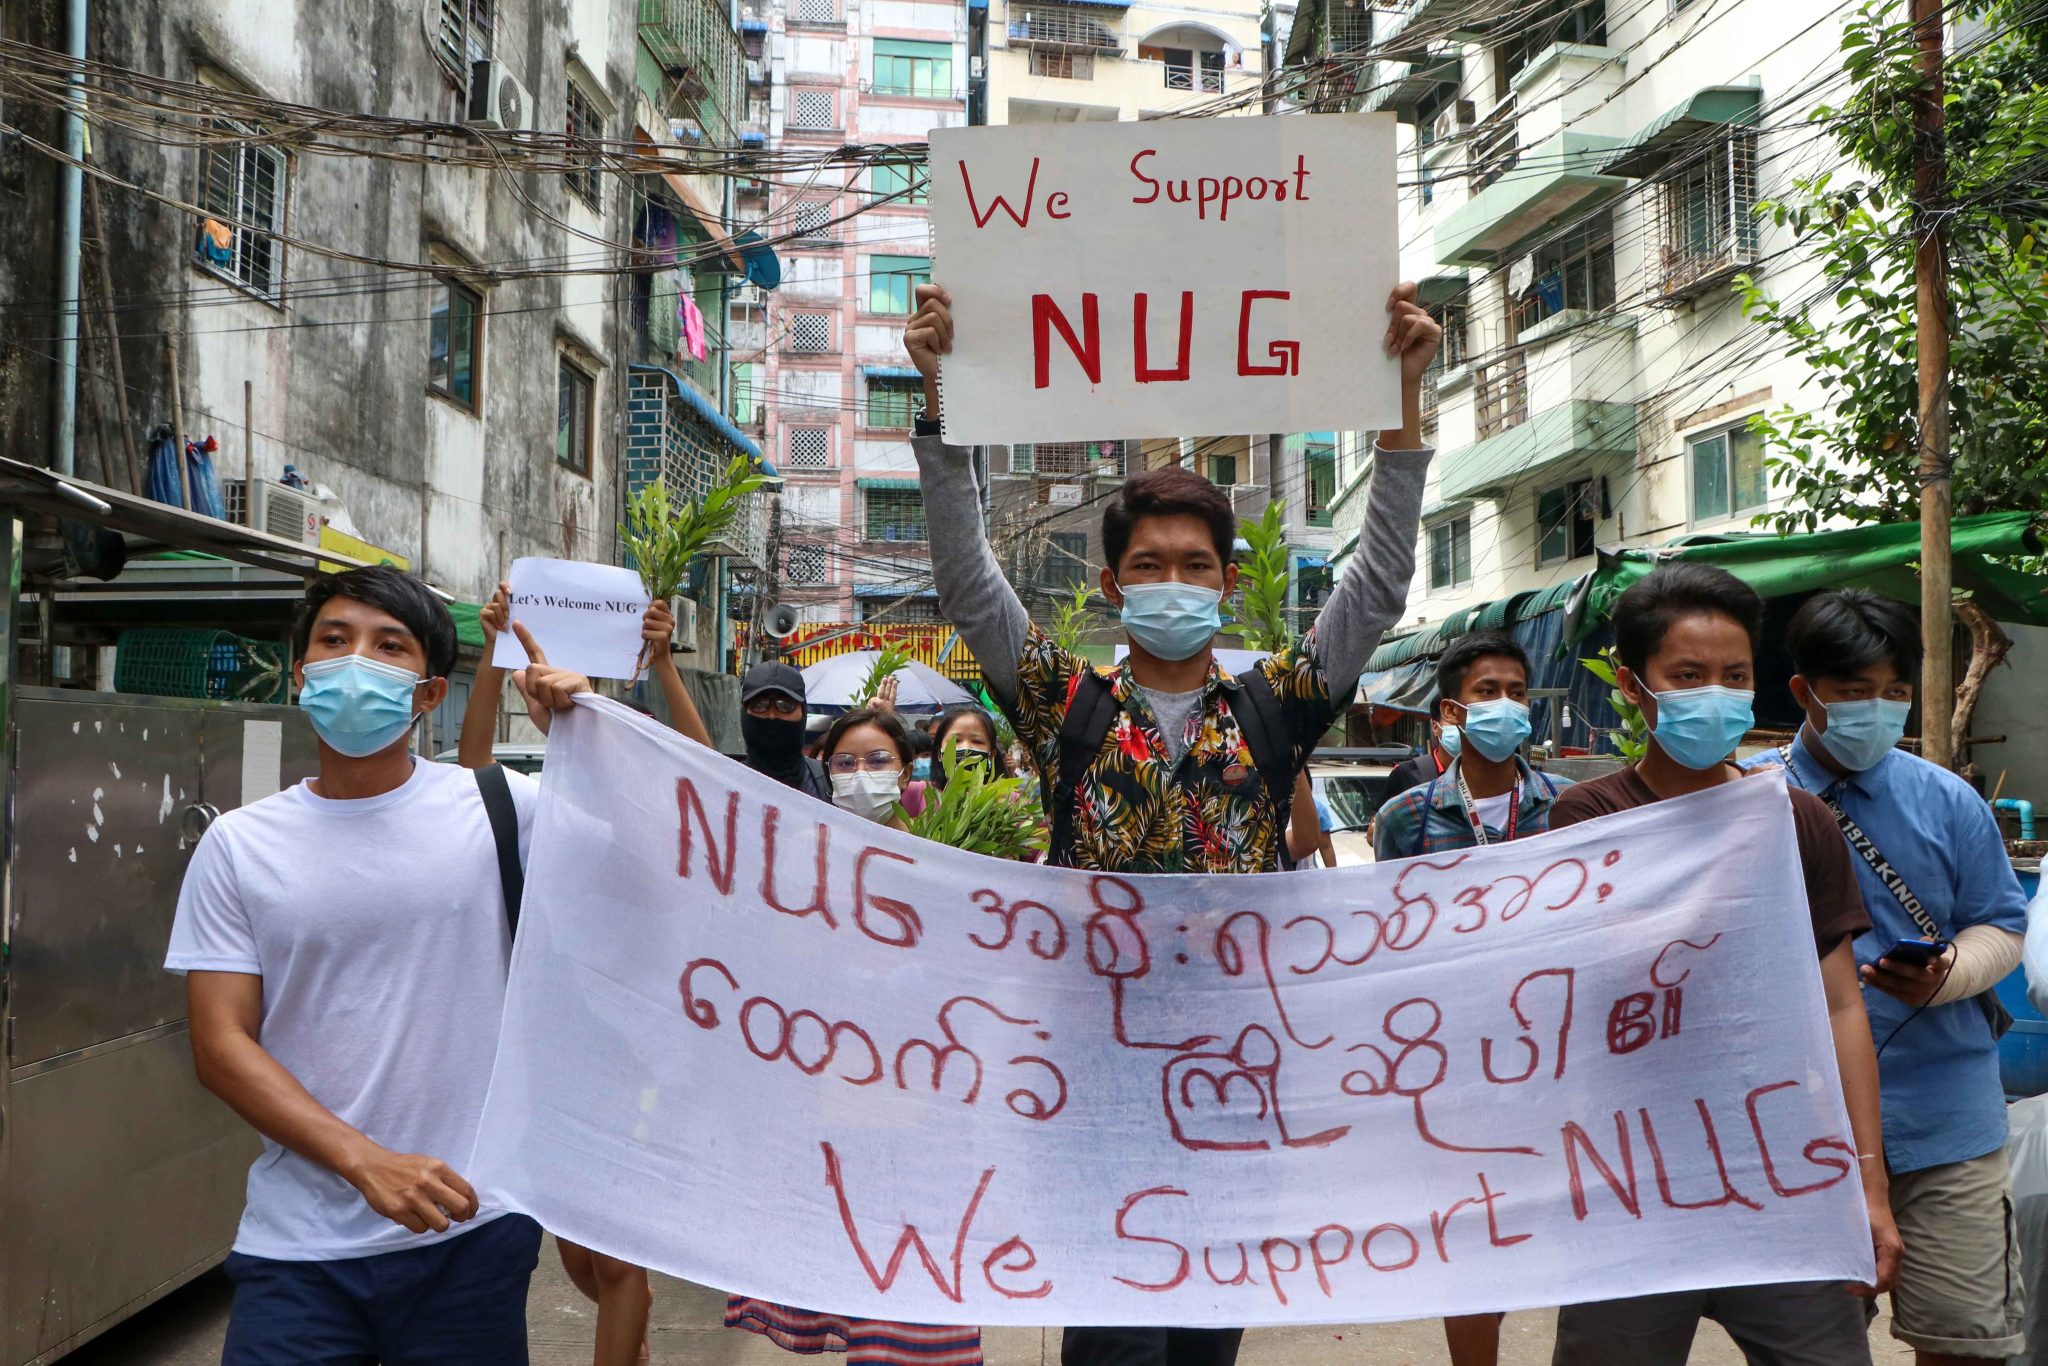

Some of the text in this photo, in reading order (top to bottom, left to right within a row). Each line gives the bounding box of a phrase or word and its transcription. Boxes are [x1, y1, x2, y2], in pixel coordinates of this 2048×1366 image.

[958, 149, 1311, 229] We Support
[1031, 289, 1301, 389] NUG
[509, 592, 637, 614] Let's Welcome NUG
[675, 776, 924, 950] NUG
[820, 1079, 1856, 1306] We Support NUG
